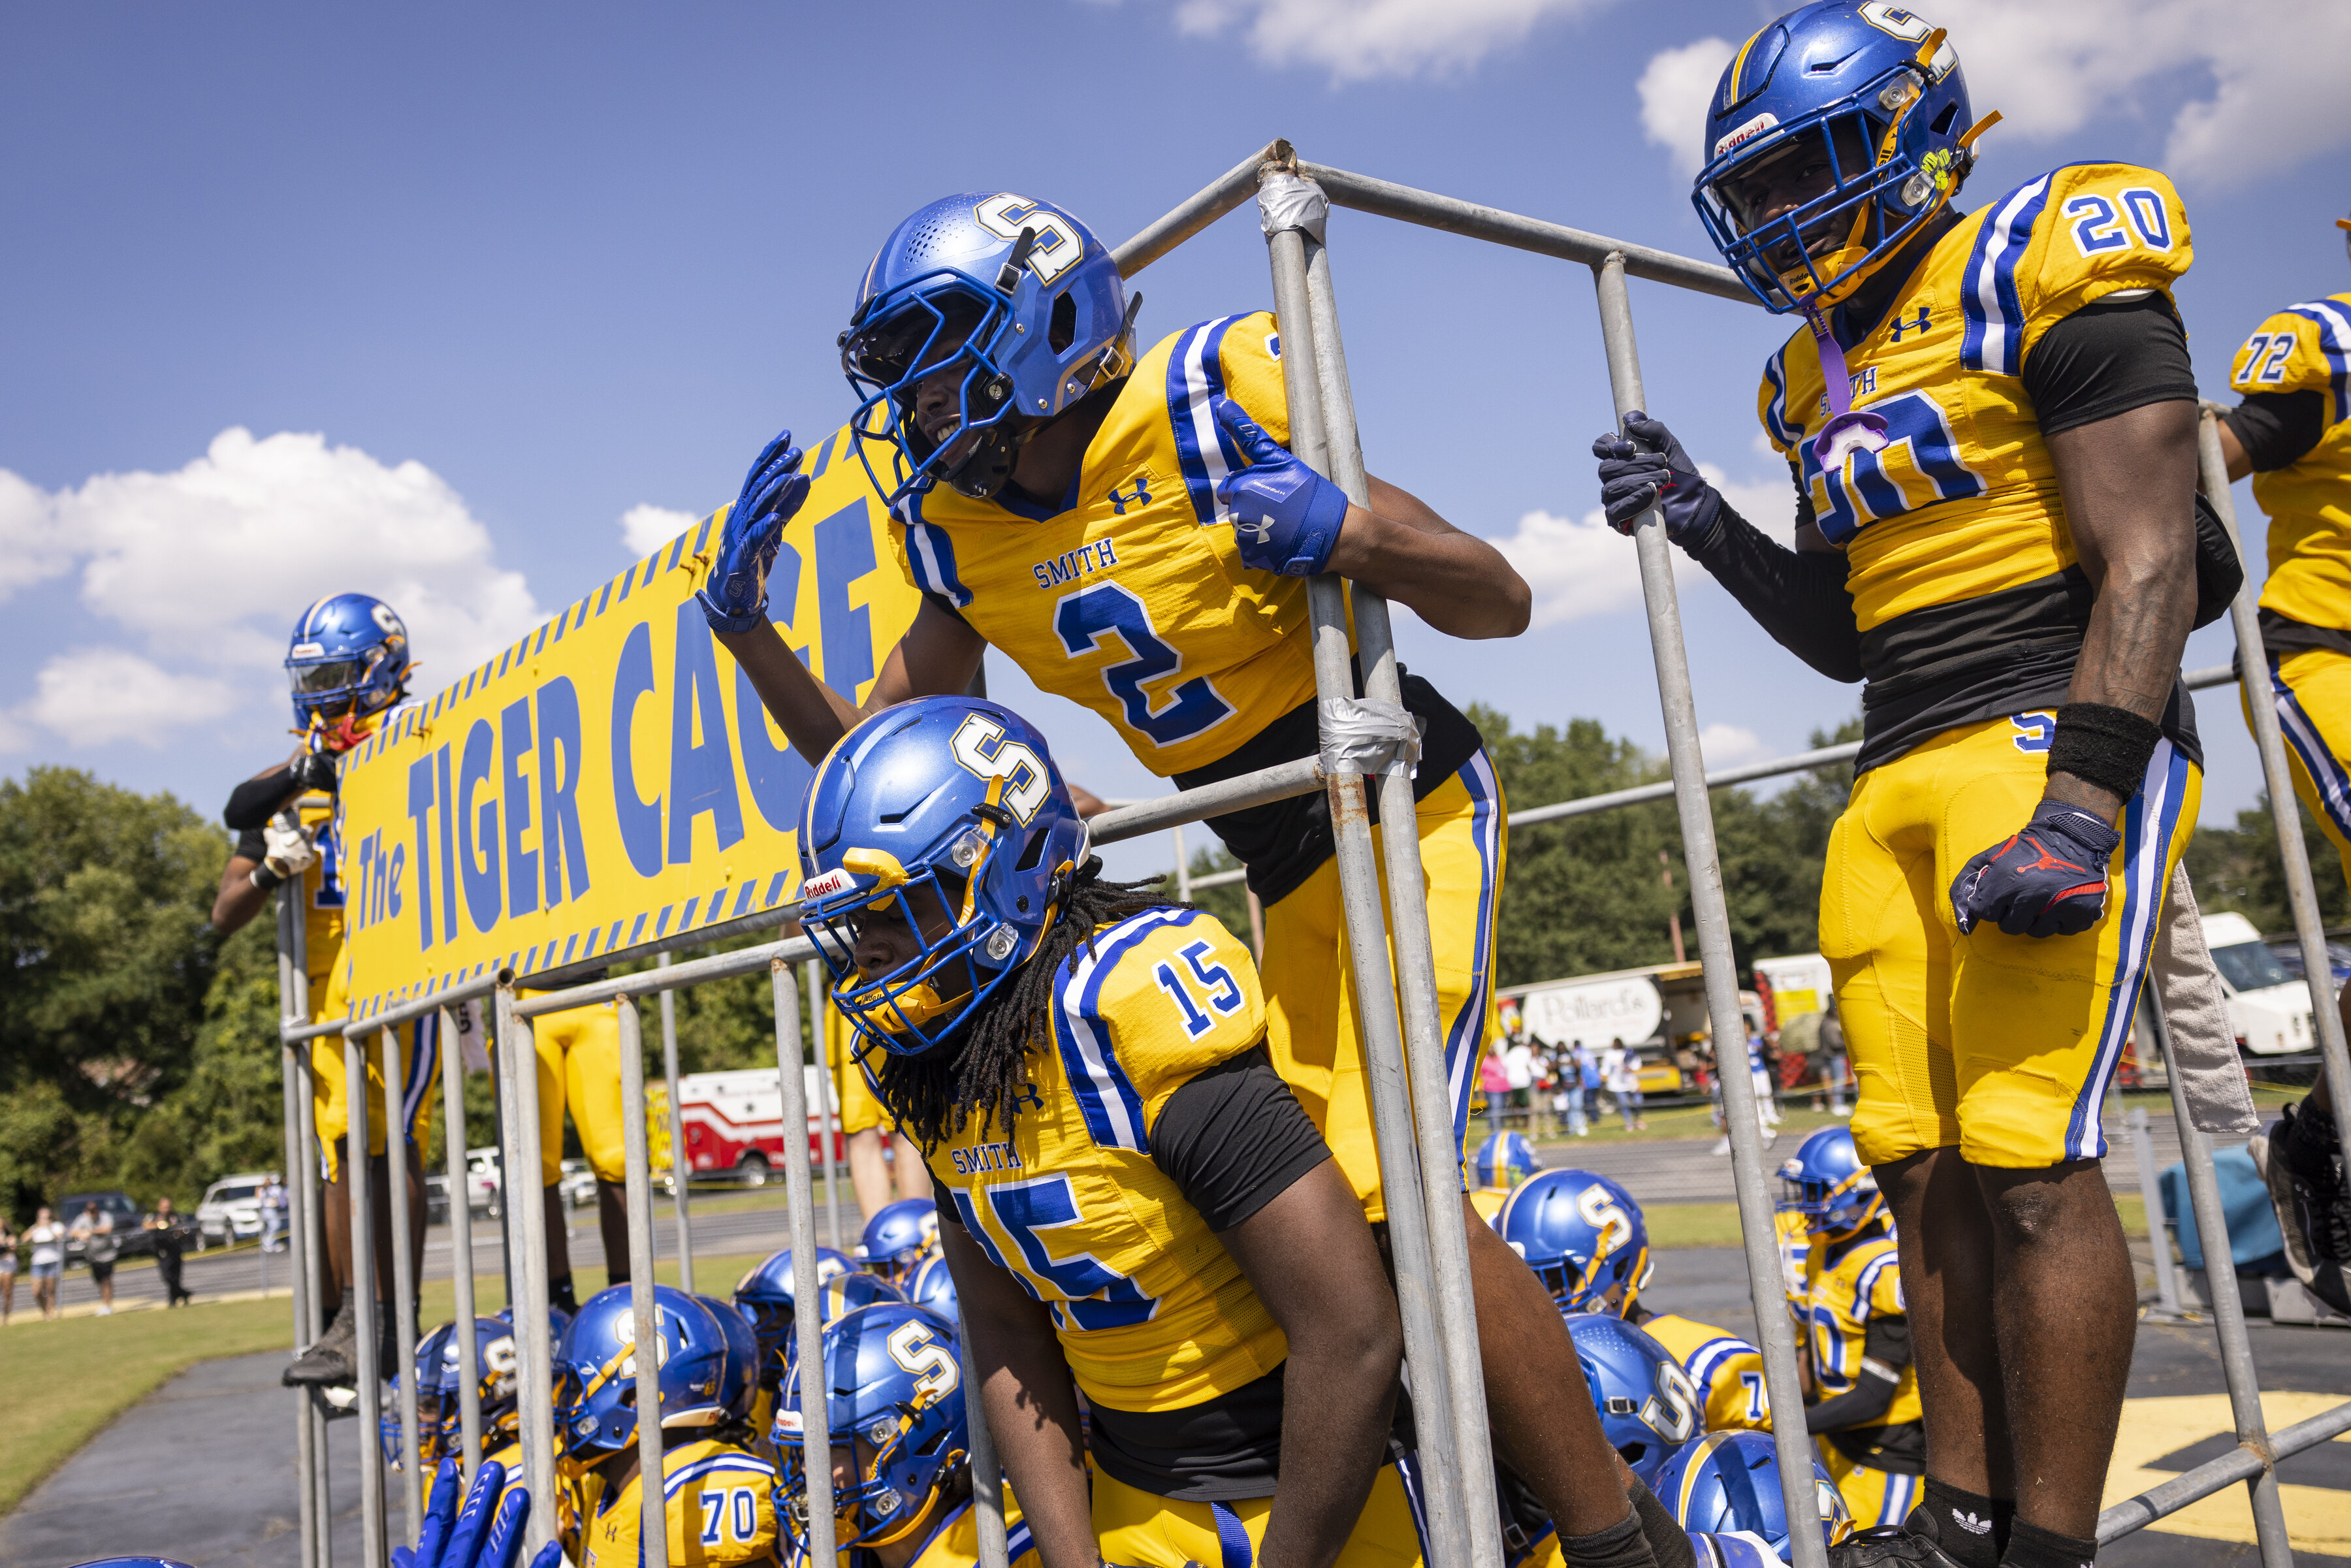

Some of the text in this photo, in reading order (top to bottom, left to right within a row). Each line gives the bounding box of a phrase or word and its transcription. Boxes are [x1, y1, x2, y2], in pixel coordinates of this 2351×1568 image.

[974, 193, 1084, 287] S
[2060, 187, 2174, 259] 20
[1819, 366, 1878, 418] STH
[2235, 332, 2297, 384] 72
[1032, 537, 1119, 590] SMITH
[1053, 579, 1238, 748] 2
[950, 712, 1051, 829] S
[358, 827, 405, 932] The
[408, 675, 590, 952] TIGER
[805, 874, 841, 899] Riddell
[1151, 937, 1245, 1043] 15
[1542, 987, 1646, 1026] Pollard's
[952, 1141, 1023, 1176] SMITH
[952, 1174, 1161, 1332] 15
[1576, 1183, 1632, 1255] S
[888, 1319, 959, 1410] S
[1739, 1371, 1769, 1421] 7
[1639, 1360, 1698, 1445] S
[698, 1486, 758, 1547] 70
